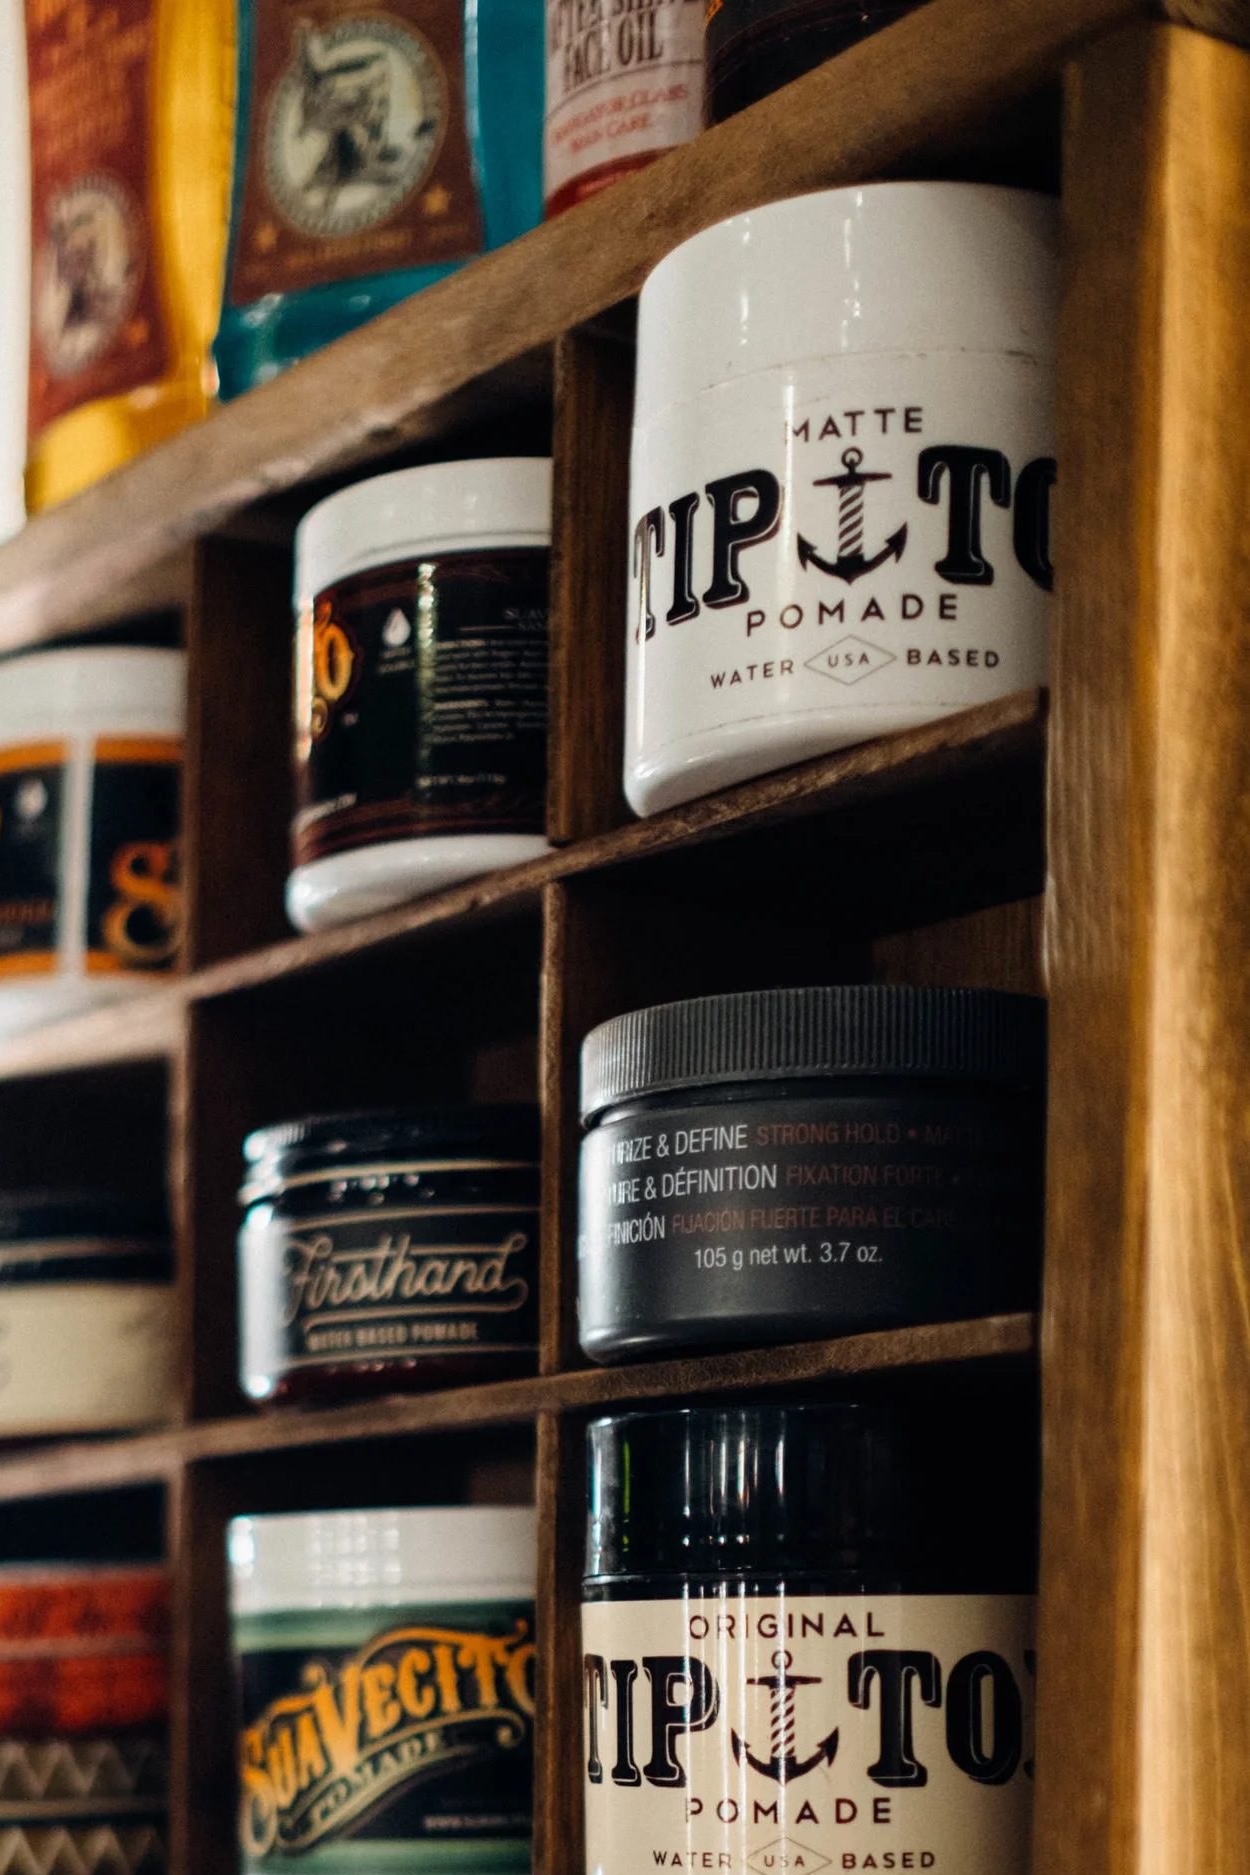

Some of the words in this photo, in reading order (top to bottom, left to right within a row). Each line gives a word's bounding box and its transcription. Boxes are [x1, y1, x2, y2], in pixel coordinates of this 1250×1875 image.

[617, 11, 663, 66] OIL
[785, 406, 924, 446] MATTE
[634, 469, 784, 644] TIP
[747, 593, 958, 637] POMADE
[710, 659, 794, 690] WATER
[827, 652, 870, 669] USA
[907, 649, 1000, 668] BASED
[657, 1133, 670, 1158] &
[675, 1124, 748, 1155] DEFINE
[756, 1123, 839, 1146] STRONG
[845, 1122, 900, 1144] HOLD
[645, 1175, 658, 1200] &
[662, 1165, 777, 1198] DÉFINITION
[786, 1163, 878, 1186] FIXATION
[751, 1206, 821, 1231] FUERTE
[827, 1205, 877, 1229] PARA
[883, 1206, 907, 1229] EL
[694, 1247, 727, 1269] 105
[732, 1252, 744, 1271] g
[750, 1247, 778, 1265] net
[784, 1243, 812, 1265] wt.
[820, 1242, 851, 1263] 3.7
[857, 1246, 883, 1263] oz.
[688, 1612, 885, 1640] ORIGINAL
[584, 1652, 720, 1788] TIP
[847, 1649, 1035, 1788] TO
[684, 1797, 892, 1825] POMADE
[653, 1849, 733, 1869] WATER
[763, 1854, 806, 1868] USA
[841, 1851, 936, 1870] BASED
